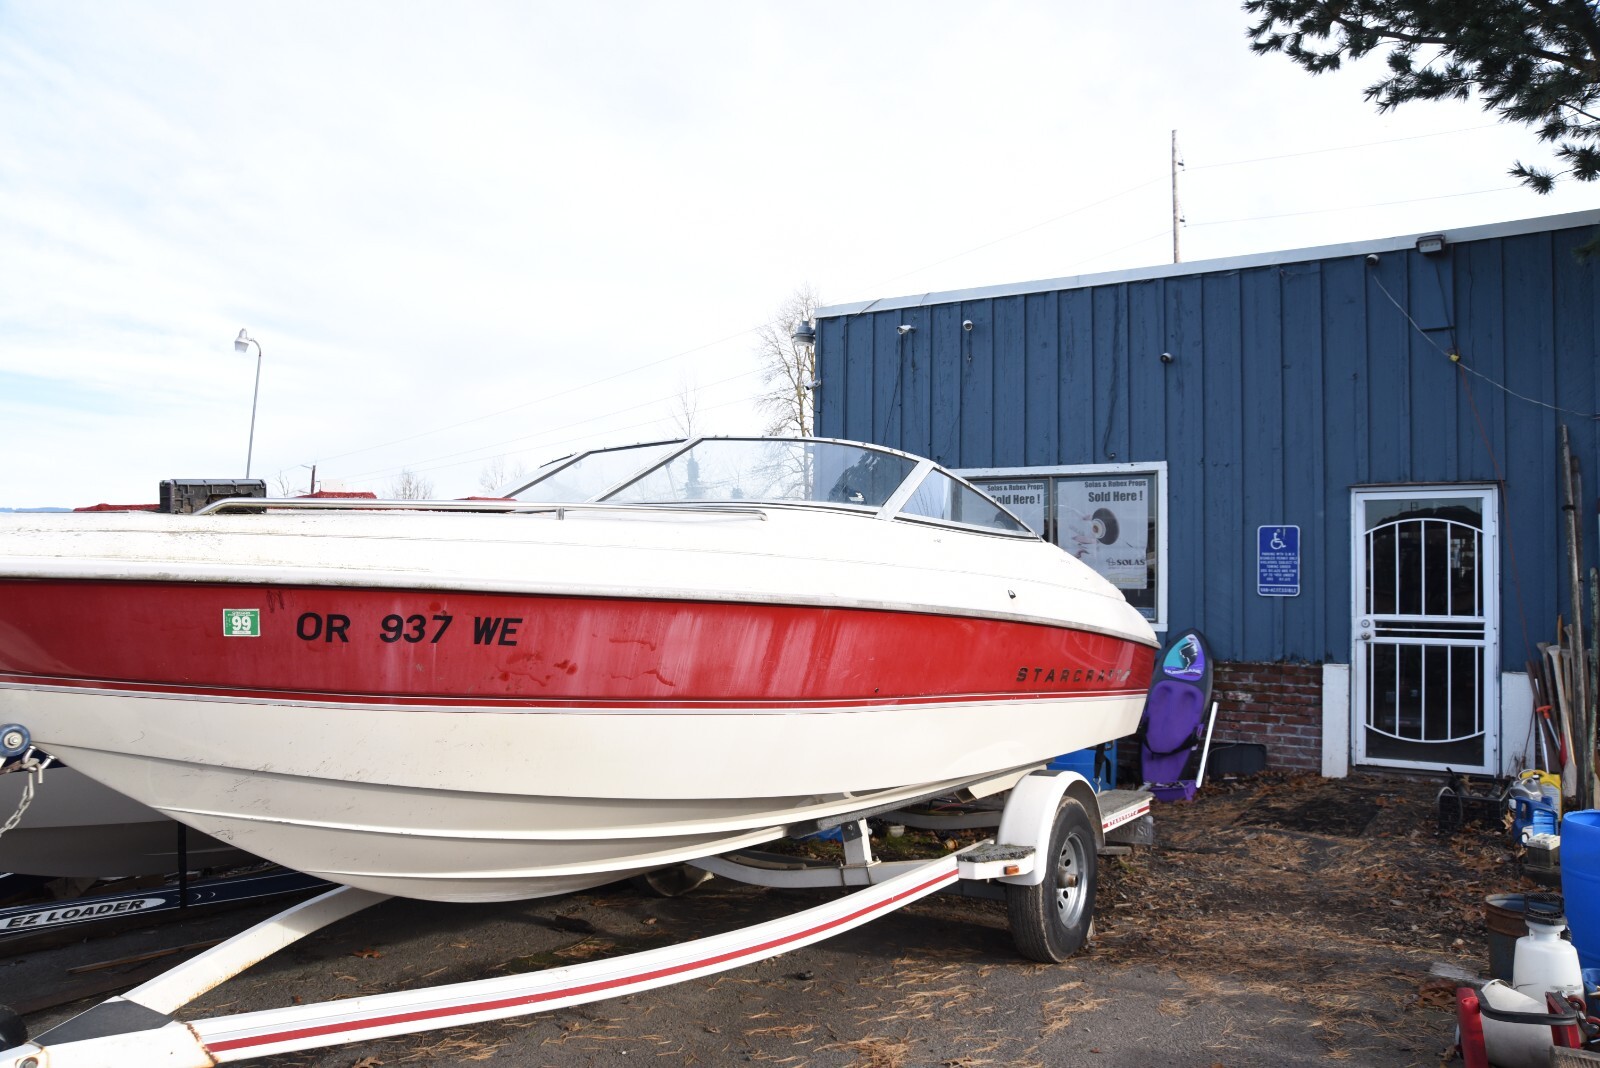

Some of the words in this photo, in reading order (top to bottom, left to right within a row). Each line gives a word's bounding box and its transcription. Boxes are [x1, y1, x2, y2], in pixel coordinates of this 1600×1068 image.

[1013, 494, 1035, 504] Here
[1088, 491, 1110, 502] Sold
[1113, 491, 1137, 501] Here
[231, 616, 252, 631] 99
[296, 612, 351, 643] OR
[379, 614, 453, 644] 937
[473, 616, 523, 646] WE
[5, 914, 41, 928] EZ
[45, 899, 146, 923] LOADER
